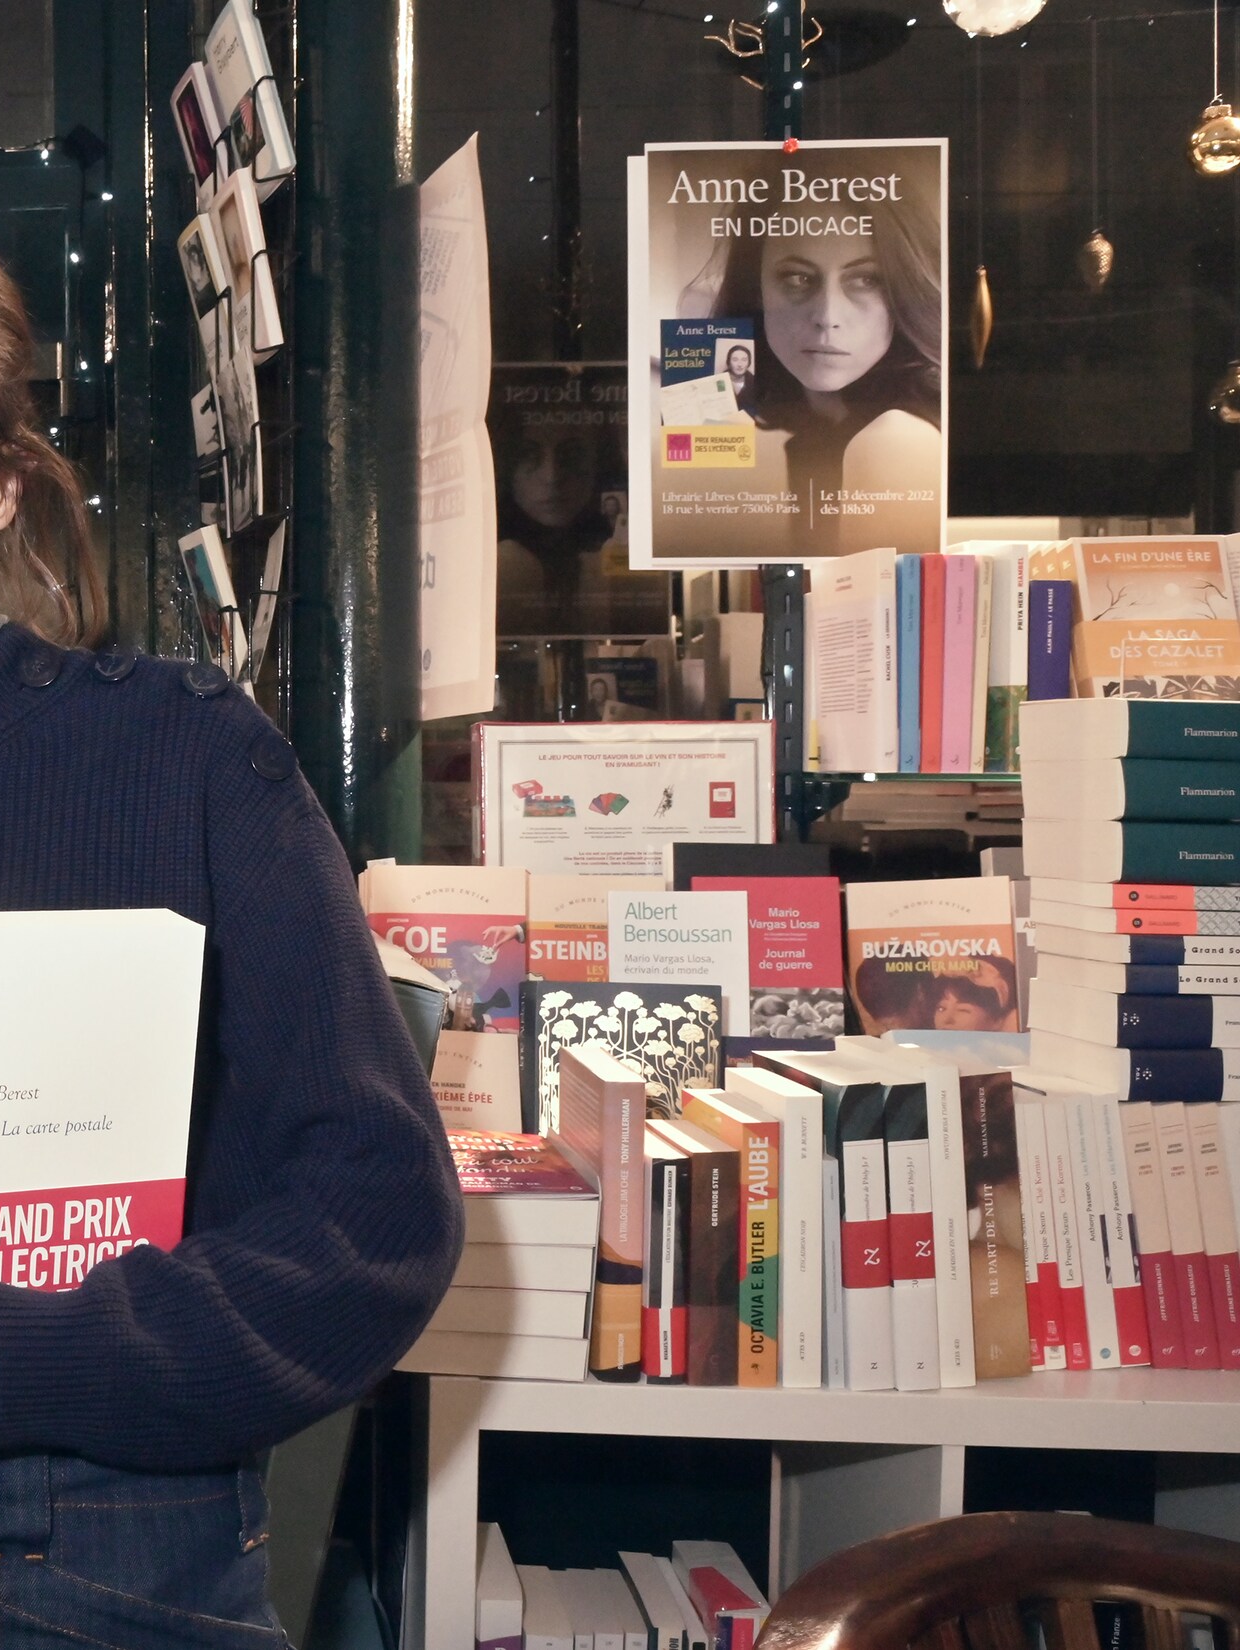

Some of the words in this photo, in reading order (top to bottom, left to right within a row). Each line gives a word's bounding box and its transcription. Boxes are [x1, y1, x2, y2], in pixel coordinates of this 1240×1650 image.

[667, 170, 768, 204] Anne
[781, 169, 902, 202] Berest
[711, 217, 742, 237] EN
[750, 213, 873, 236] DÉDICACE
[676, 325, 703, 335] Anne
[707, 325, 736, 335] Berest
[665, 348, 679, 357] La
[681, 348, 711, 357] Carte
[665, 358, 705, 370] postale
[662, 491, 702, 502] Librairie
[705, 491, 735, 502] Libres
[737, 491, 778, 503] Champs
[820, 490, 834, 501] Le
[837, 490, 849, 501] 13
[851, 490, 906, 501] décembre
[908, 490, 934, 501] 2022
[662, 505, 673, 514] 18
[675, 506, 693, 514] rue
[695, 505, 704, 514] le
[706, 505, 739, 514] verrier
[742, 504, 774, 514] 75006
[776, 504, 800, 514] Paris
[820, 504, 840, 515] dès
[842, 504, 875, 515] 18h30
[1093, 553, 1111, 564] LA
[1115, 552, 1137, 562] FIN
[1141, 551, 1183, 562] D'UNE
[1187, 549, 1212, 562] ÈRE
[1111, 645, 1142, 659] DES
[1146, 645, 1225, 659] CAZALET
[1184, 727, 1238, 737] Flammarion
[1180, 787, 1235, 796] Flammarion
[1179, 851, 1234, 860] Flammarion
[625, 902, 677, 920] Albert
[768, 908, 799, 917] Mario
[749, 919, 786, 930] Vargas
[790, 920, 820, 929] Llosa
[386, 926, 447, 954] COE
[624, 925, 732, 943] Bensoussan
[530, 939, 607, 961] STEINB
[765, 949, 805, 959] Journal
[862, 937, 1002, 959] BUŽAROVSKA
[1192, 946, 1224, 954] Grand
[624, 954, 650, 963] Mario
[653, 954, 684, 966] Vargas
[688, 954, 715, 965] Llosa,
[758, 960, 773, 970] de
[776, 961, 813, 972] guerre
[885, 961, 913, 973] MON
[915, 961, 945, 972] CHER
[948, 960, 979, 971] MARI
[624, 966, 660, 975] écrivain
[663, 966, 674, 975] du
[678, 966, 709, 975] monde
[468, 1091, 493, 1104] ÉPÉE
[1, 1119, 21, 1137] La
[25, 1120, 60, 1135] carte
[65, 1115, 113, 1137] postale
[621, 1098, 631, 1145] HILLERMAN
[621, 1147, 629, 1164] TONY
[620, 1169, 629, 1187] CHEE
[748, 1136, 770, 1211] L'AUBE
[620, 1188, 628, 1203] JIM
[983, 1183, 993, 1213] NUIT
[1086, 1181, 1094, 1212] Passeron
[711, 1191, 719, 1227] GERTRUDE
[63, 1195, 133, 1241] PRIX
[986, 1220, 995, 1239] DE
[1089, 1213, 1097, 1242] Anthony
[1116, 1212, 1124, 1242] Anthony
[751, 1221, 765, 1276] BUTLER
[986, 1242, 997, 1272] PART
[751, 1278, 765, 1295] E.
[751, 1297, 765, 1354] OCTAVIA
